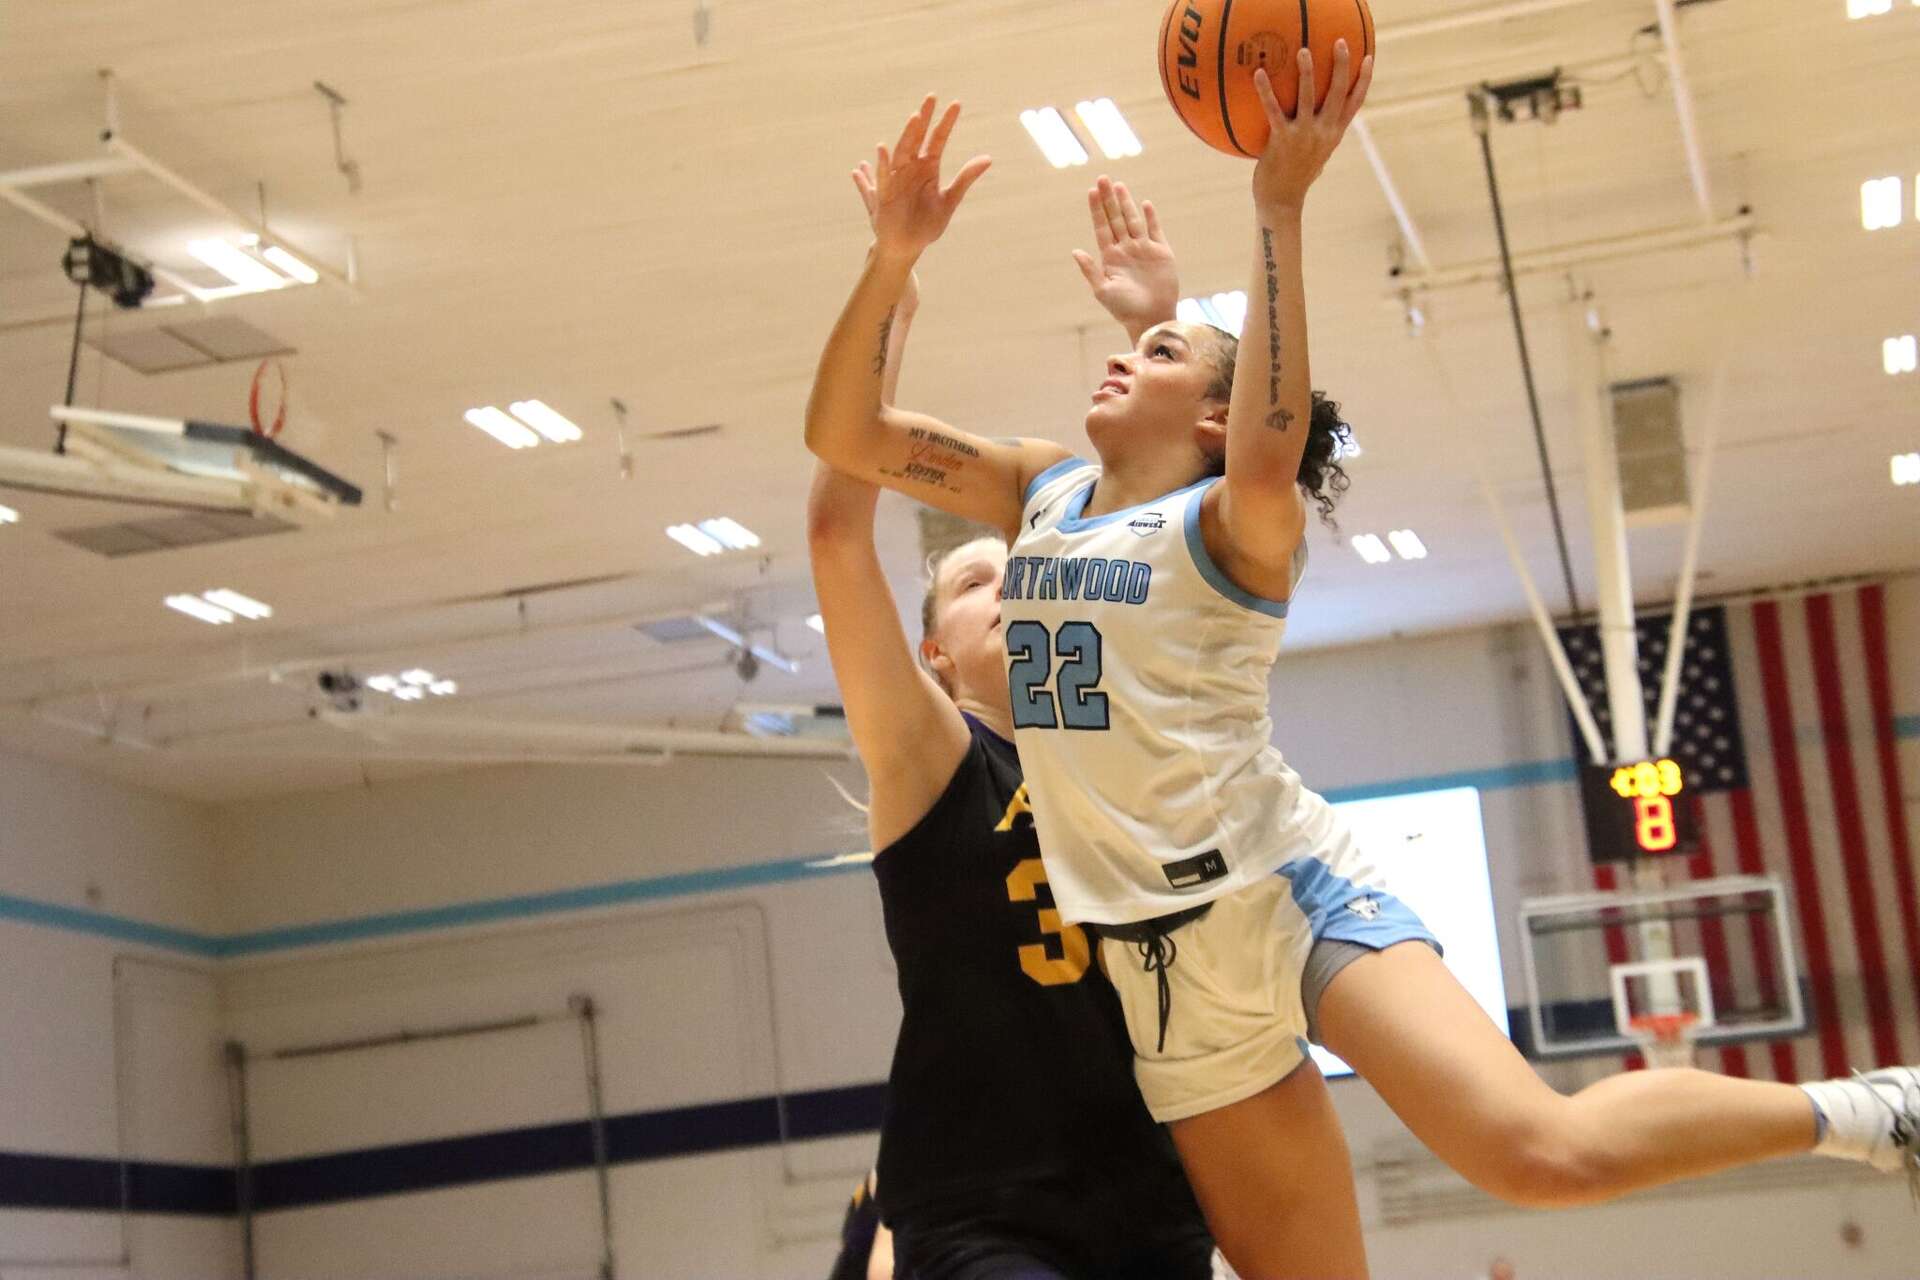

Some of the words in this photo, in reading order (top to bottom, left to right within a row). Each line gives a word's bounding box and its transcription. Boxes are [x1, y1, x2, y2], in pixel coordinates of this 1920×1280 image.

[1177, 5, 1202, 101] EVO
[908, 427, 927, 441] MY
[928, 431, 980, 458] BROTHERS
[1006, 620, 1110, 730] 22
[1634, 797, 1676, 851] 8
[1204, 859, 1217, 873] M
[1006, 858, 1091, 986] 3
